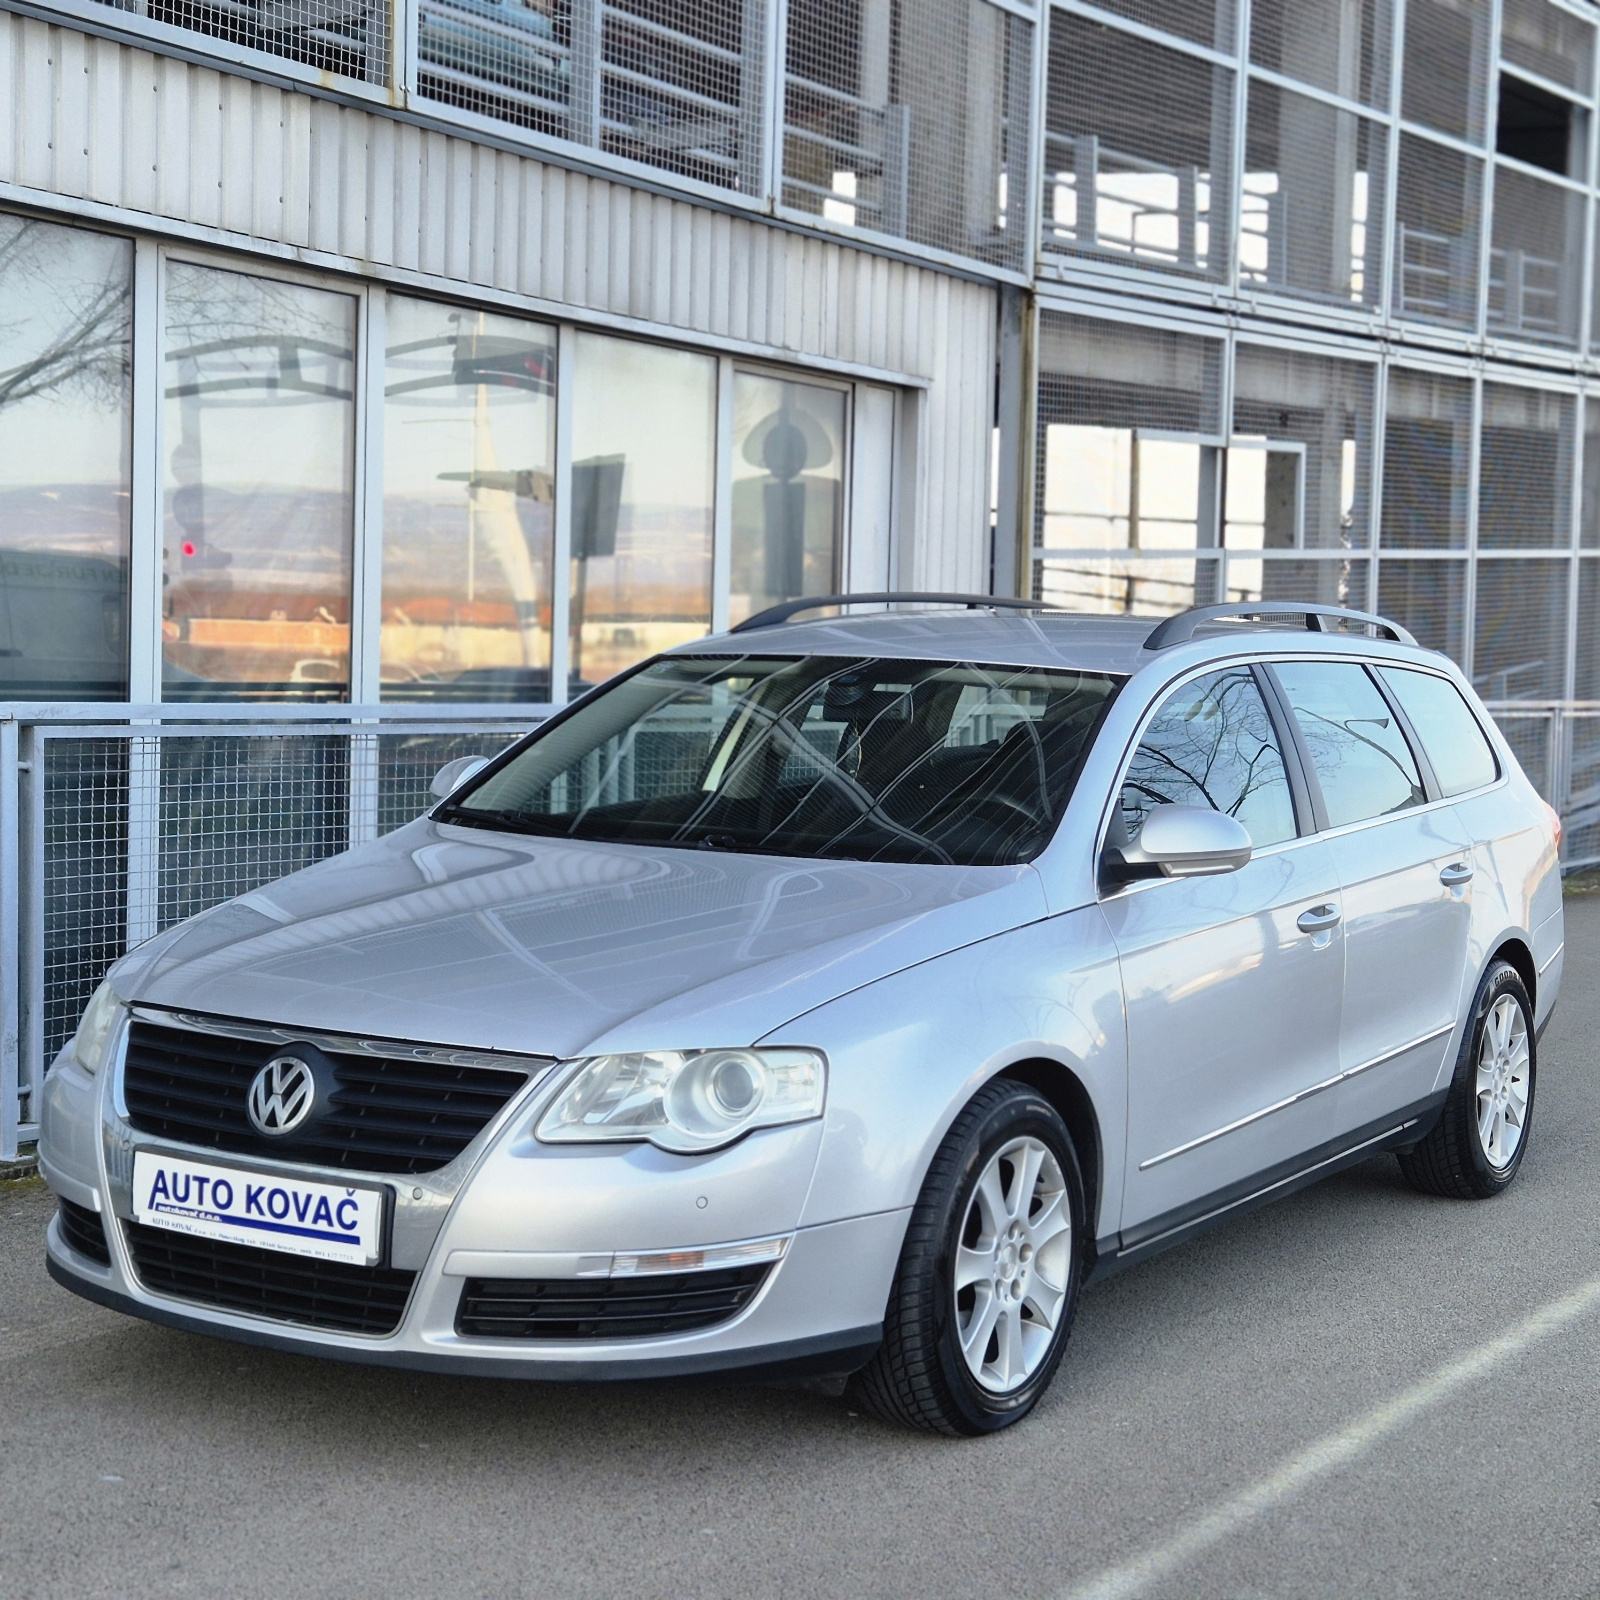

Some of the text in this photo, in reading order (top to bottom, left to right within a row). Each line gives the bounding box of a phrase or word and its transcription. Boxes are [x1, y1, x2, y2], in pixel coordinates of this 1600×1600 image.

[248, 1056, 314, 1136] VW
[148, 1169, 360, 1231] AUTO KOVAČ
